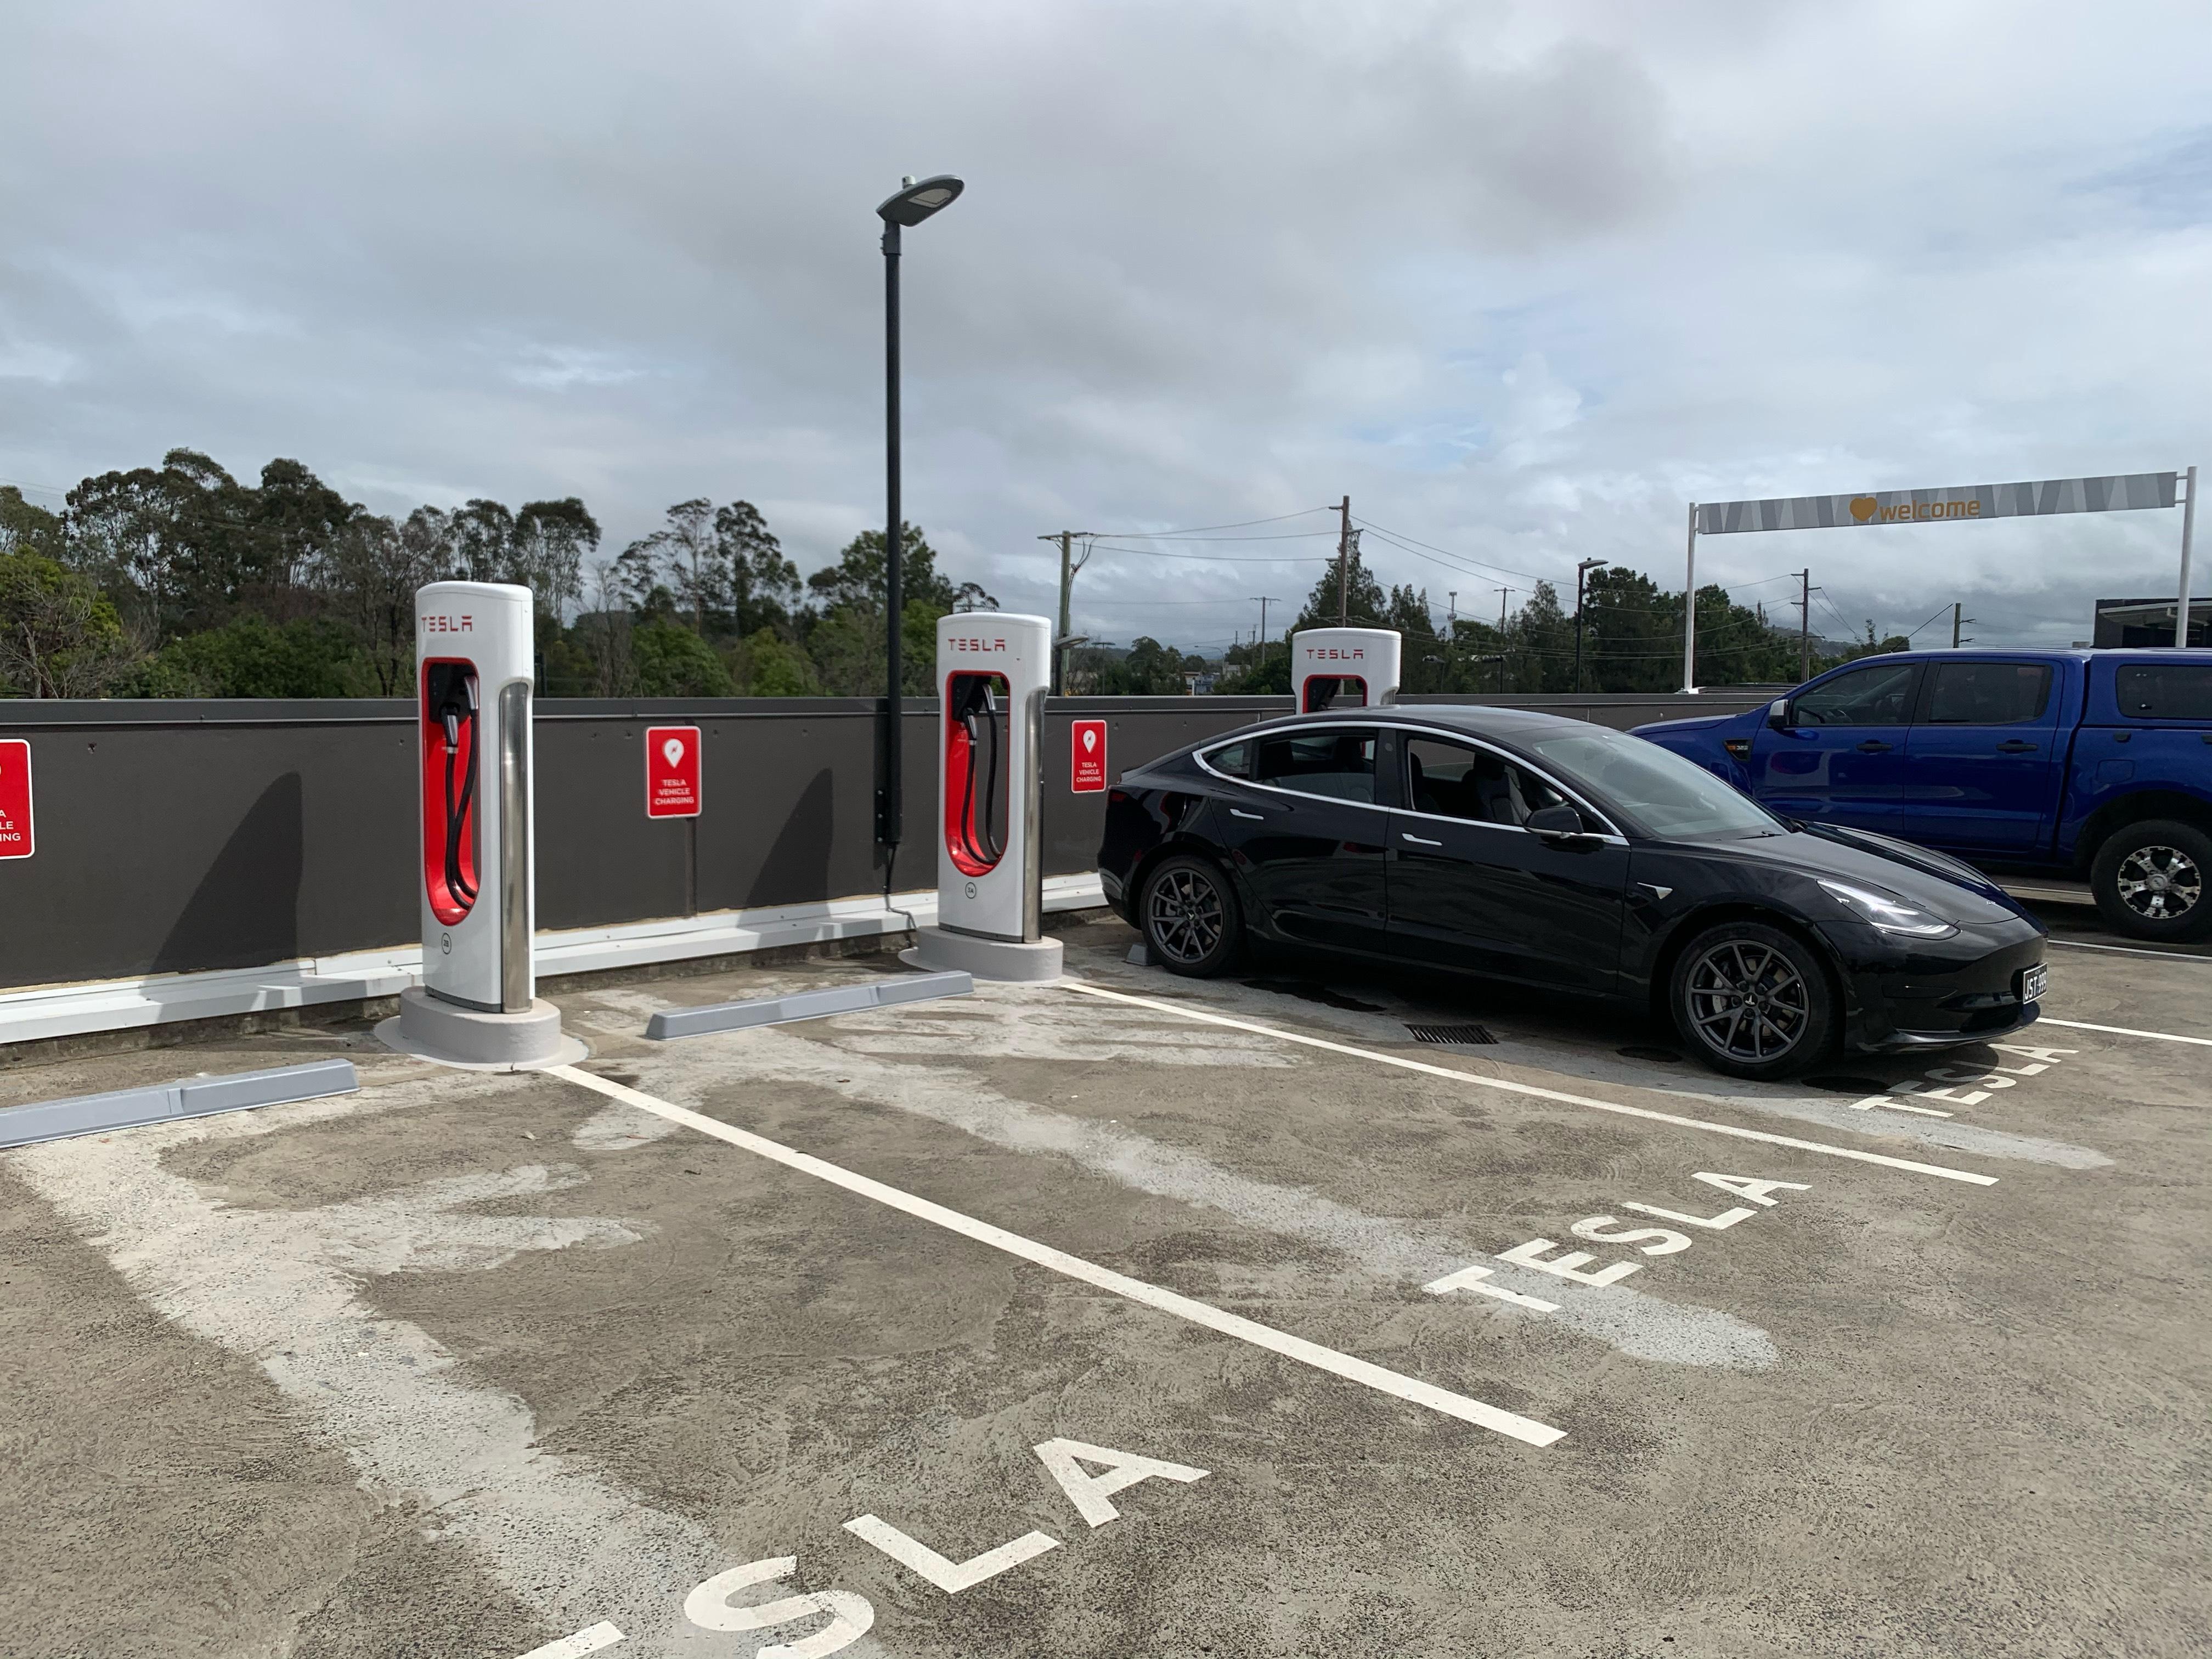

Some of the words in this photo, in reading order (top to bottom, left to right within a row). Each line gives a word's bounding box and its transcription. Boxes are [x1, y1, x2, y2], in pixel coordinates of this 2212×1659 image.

[1879, 500, 1981, 521] welcome
[421, 616, 472, 633] TESLA
[948, 639, 1006, 651] TESLA
[1306, 649, 1364, 659] TESLA
[654, 796, 695, 805] CHARGING
[658, 788, 691, 796] VEHICLE
[1849, 1043, 2079, 1118] TESLA
[1421, 1172, 1813, 1312] TESLA
[514, 1437, 1212, 1659] SLA
